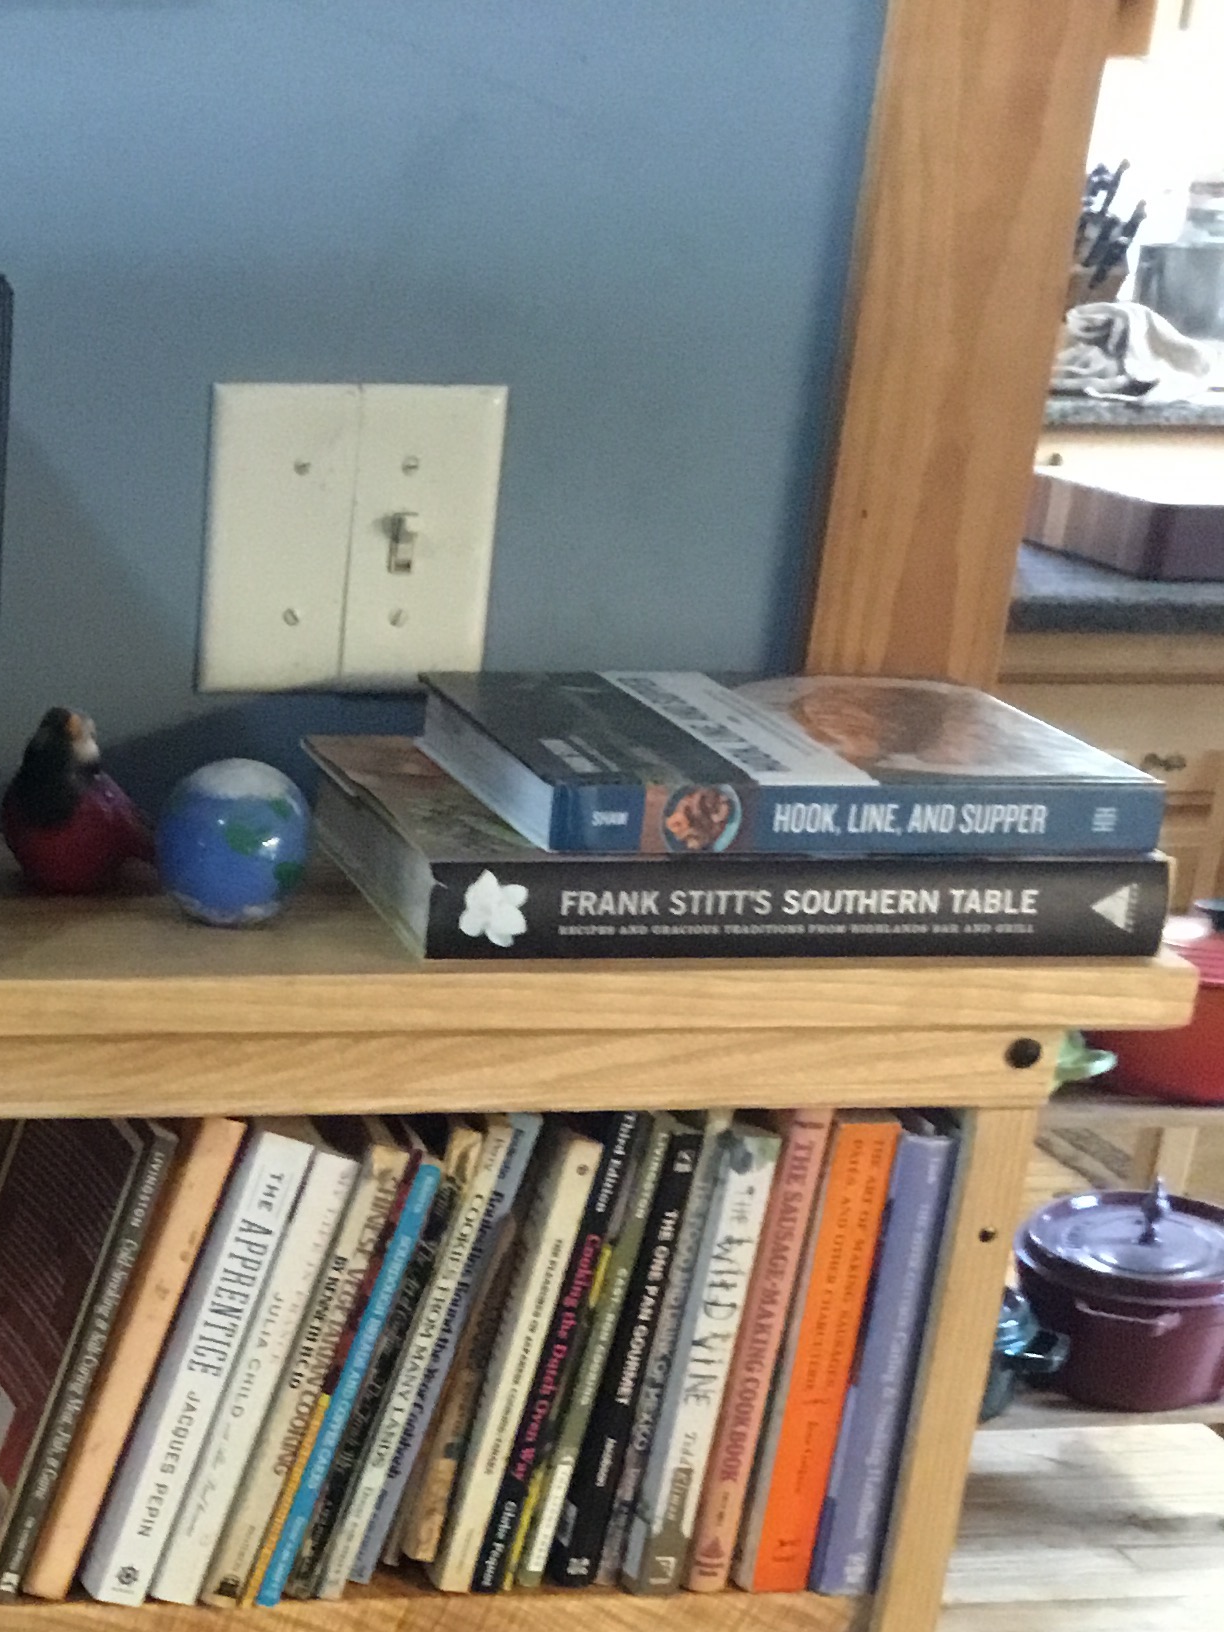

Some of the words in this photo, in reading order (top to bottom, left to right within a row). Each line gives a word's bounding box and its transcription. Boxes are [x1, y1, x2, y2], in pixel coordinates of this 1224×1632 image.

[772, 802, 841, 836] HOOK,
[847, 803, 903, 837] LINE,
[907, 804, 954, 833] AND
[959, 804, 1049, 835] SUPPER
[559, 889, 660, 917] FRANK
[669, 889, 773, 917] STITT'S
[782, 889, 942, 916] SOUTHERN
[949, 888, 1040, 915] TABLE
[610, 1110, 637, 1156] Third
[127, 1150, 164, 1228] LIVINGSTON
[254, 1168, 286, 1213] THE
[592, 1157, 623, 1215] Edition
[785, 1138, 813, 1187] THE
[655, 1206, 679, 1244] THE
[562, 1231, 601, 1310] Cooking
[645, 1243, 670, 1283] ONE
[742, 1187, 802, 1374] SAUSAGE-MAKING
[185, 1217, 275, 1381] APPRENTICE
[254, 1291, 286, 1350] JULIA
[556, 1310, 576, 1340] the
[635, 1283, 660, 1322] PAN
[228, 1355, 262, 1420] CHILD
[538, 1342, 568, 1398] Dutch
[613, 1322, 650, 1406] GOURMET
[157, 1389, 202, 1476] JACQUES
[524, 1397, 550, 1443] Oven
[717, 1375, 761, 1485] COOKBOOK
[508, 1444, 536, 1482] Way
[135, 1481, 170, 1540] PEPIN
